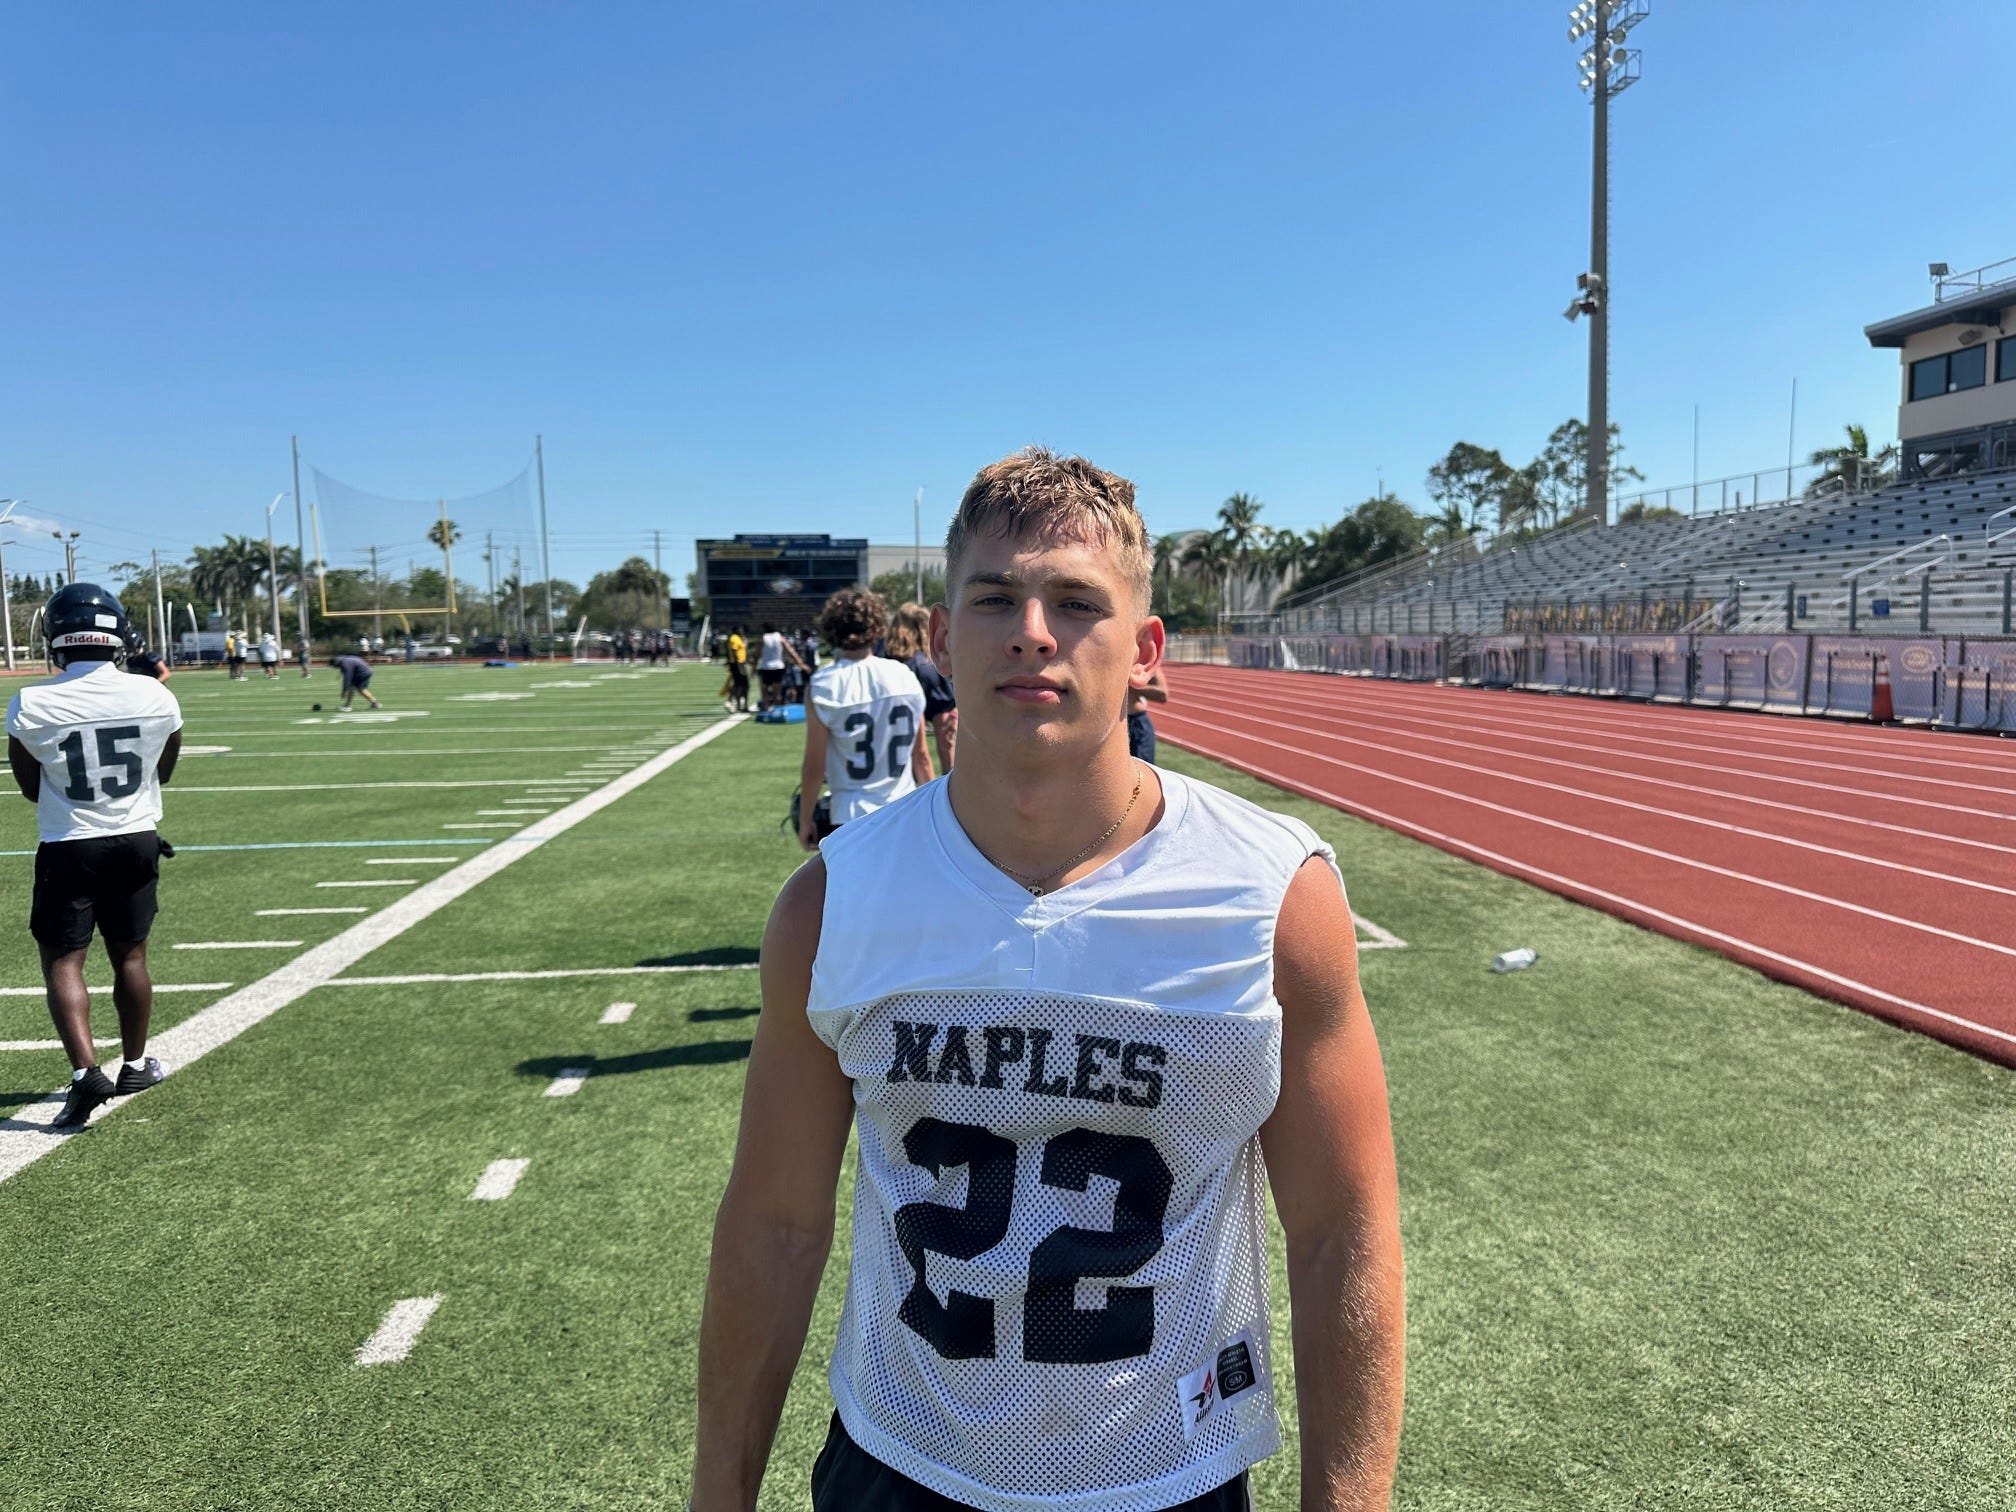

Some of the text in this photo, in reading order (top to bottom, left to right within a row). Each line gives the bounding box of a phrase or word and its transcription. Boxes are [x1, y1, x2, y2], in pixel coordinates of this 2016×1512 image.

[64, 635, 110, 645] Riddell
[58, 725, 143, 801] 15
[845, 704, 915, 780] 32
[887, 1020, 1167, 1110] NAPLES
[893, 1117, 1174, 1364] 22
